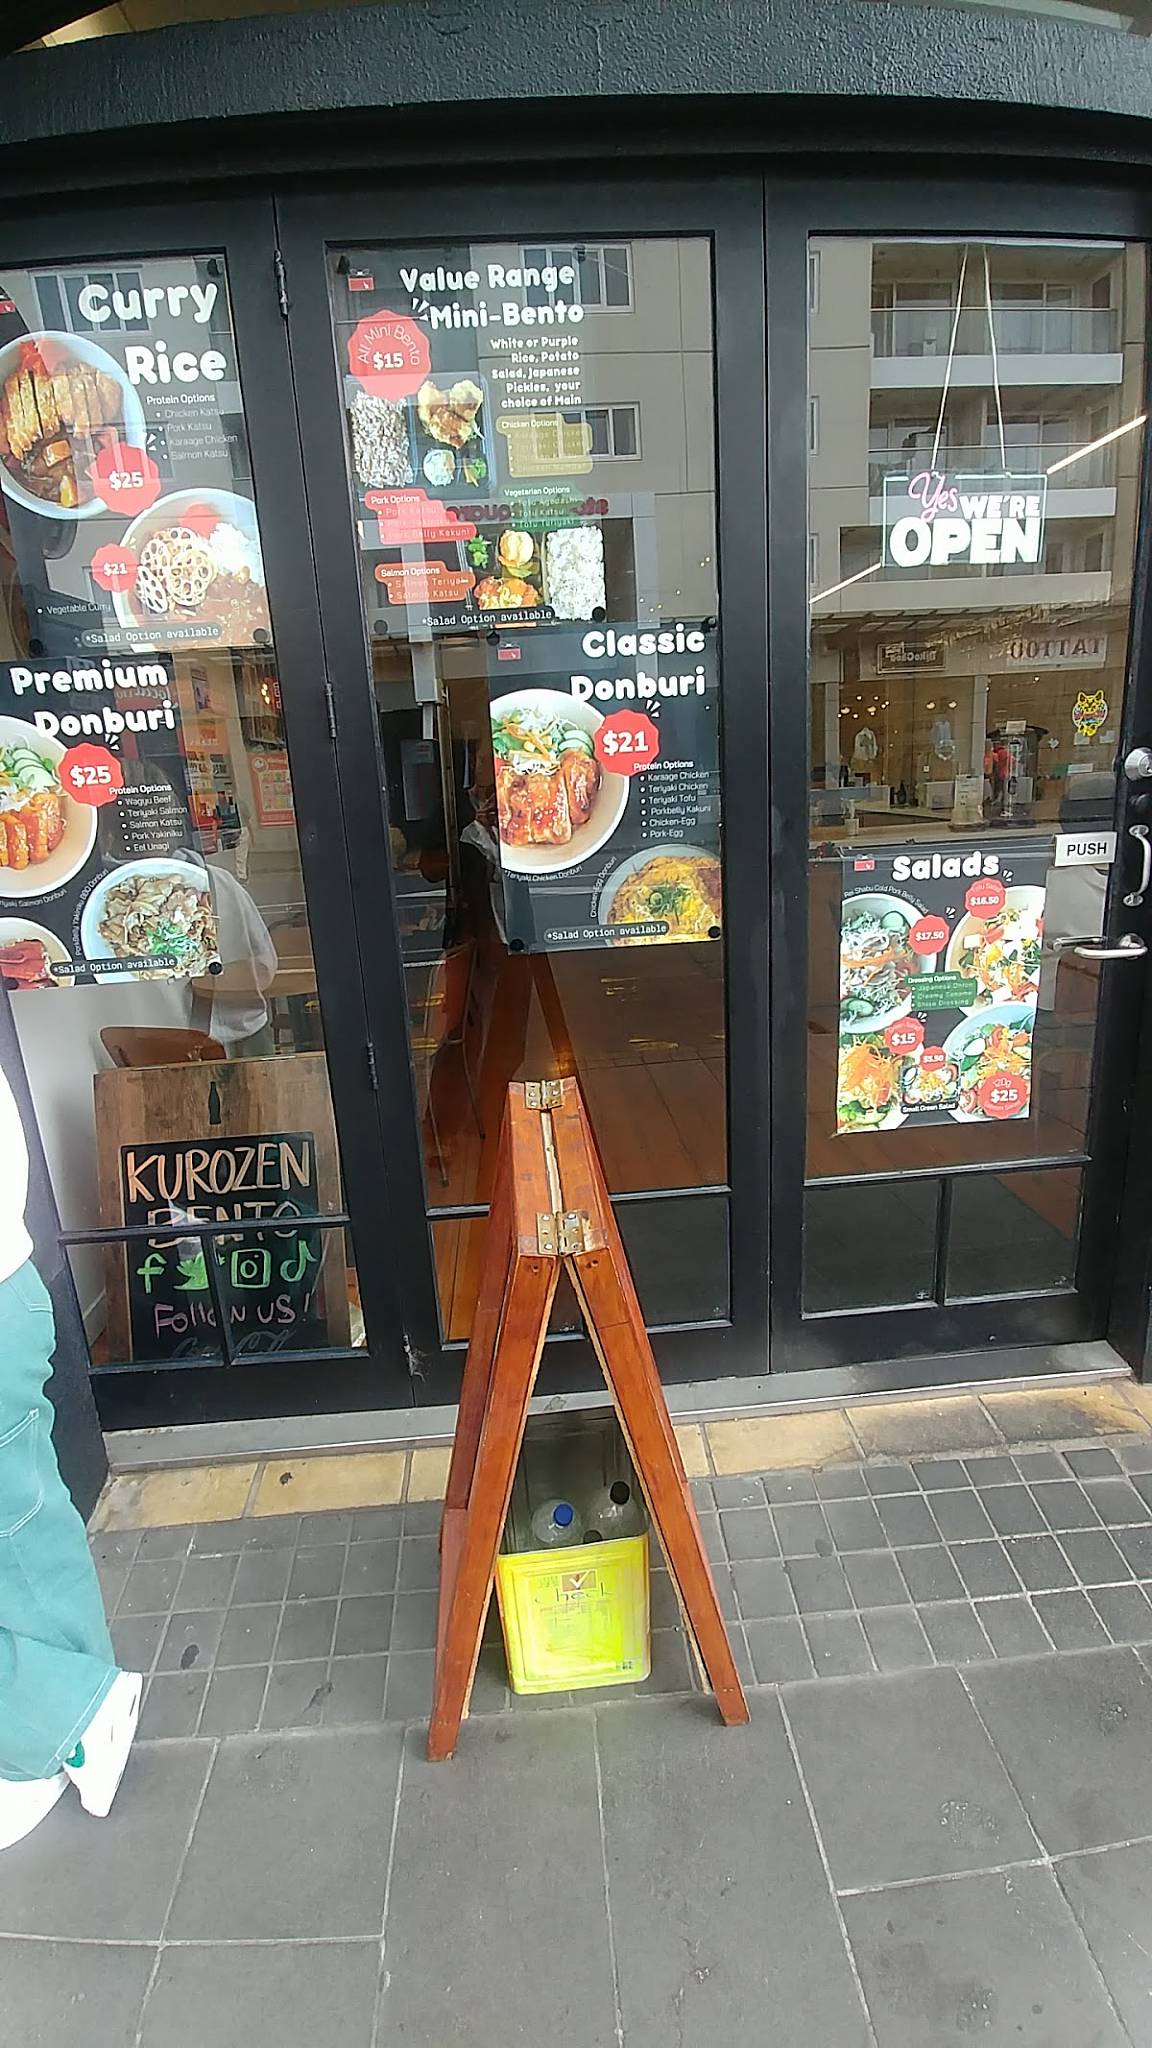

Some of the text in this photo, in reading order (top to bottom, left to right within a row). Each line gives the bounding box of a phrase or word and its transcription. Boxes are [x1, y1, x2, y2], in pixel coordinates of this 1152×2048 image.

[399, 264, 575, 292] Value Range
[78, 283, 218, 323] Curry
[430, 300, 584, 330] Mini-Bento
[357, 323, 420, 366] All Mini Bento
[490, 336, 579, 349] White or Purple
[124, 340, 227, 385] Rice
[373, 352, 404, 371] $15
[511, 350, 580, 363] Rice, Potato
[528, 367, 580, 380] Japanese
[506, 381, 581, 393] Pickles, your
[146, 393, 216, 405] Protein Options
[501, 394, 582, 408] choice of Main
[501, 419, 559, 429] Chicken Options
[109, 471, 144, 490] $25
[504, 486, 571, 498] Vegetarian Options
[908, 472, 1041, 522] Yes WE'RE
[371, 494, 420, 505] Pork Options
[889, 517, 1041, 568] OPEN
[103, 562, 128, 577] $21
[381, 566, 440, 578] Salmon Options
[433, 589, 459, 597] Katsu
[46, 604, 87, 615] Vegetable
[461, 614, 496, 625] Option
[501, 610, 552, 621] available
[126, 630, 162, 642] Option
[167, 627, 219, 639] available
[582, 623, 705, 658] Classic
[10, 659, 169, 695] Premium
[570, 665, 705, 701] Donburi
[34, 700, 176, 737] Donburi
[602, 729, 649, 756] $21
[633, 760, 694, 771] Protein Options
[70, 765, 111, 787] $25
[679, 771, 710, 779] Chicken
[109, 784, 172, 795] Protein Options
[648, 782, 709, 793] Teriyaki Chicken
[153, 795, 171, 804] Beef
[648, 794, 697, 805] Teriyaki Tofu
[128, 806, 188, 818] Teriyaki Salmon
[650, 807, 686, 816] Porkbelly
[130, 818, 183, 829] Salmon Katsu
[649, 817, 696, 827] Chicken-Egg
[131, 830, 183, 840] Pork Yakiniku
[649, 828, 684, 838] Pork-Egg
[133, 841, 170, 852] Eel Unagi
[1066, 842, 1107, 857] PUSH
[892, 851, 1000, 882] Salads
[583, 929, 615, 939] Option
[620, 925, 667, 935] available
[915, 931, 945, 942] $17.50
[90, 961, 123, 972] Option
[127, 957, 175, 969] available
[891, 1032, 916, 1045] $15
[990, 1089, 1019, 1103] $25
[126, 1141, 310, 1203] KUROZEN
